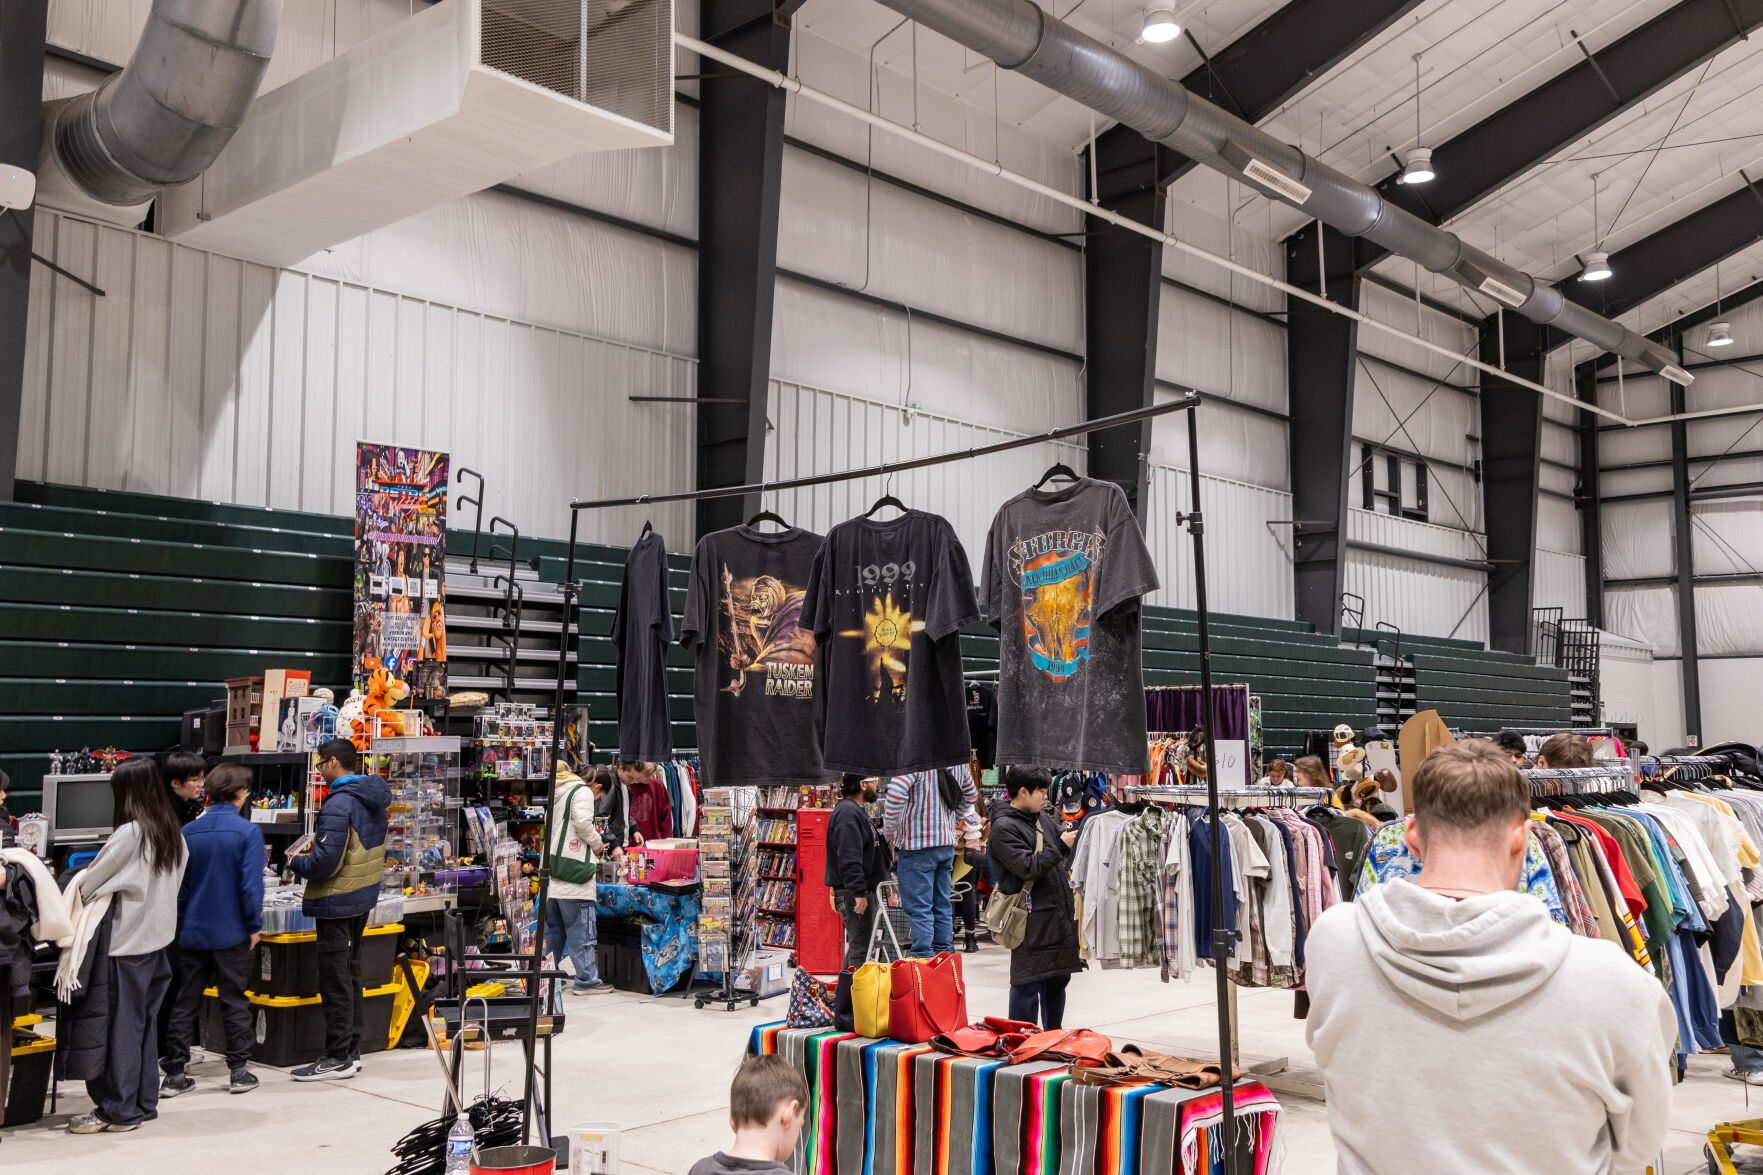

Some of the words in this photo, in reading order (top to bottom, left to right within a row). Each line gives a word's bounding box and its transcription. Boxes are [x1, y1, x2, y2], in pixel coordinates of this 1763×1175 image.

[854, 561, 916, 586] 1999
[766, 661, 814, 680] TUSKEN
[765, 679, 813, 697] RAIDER
